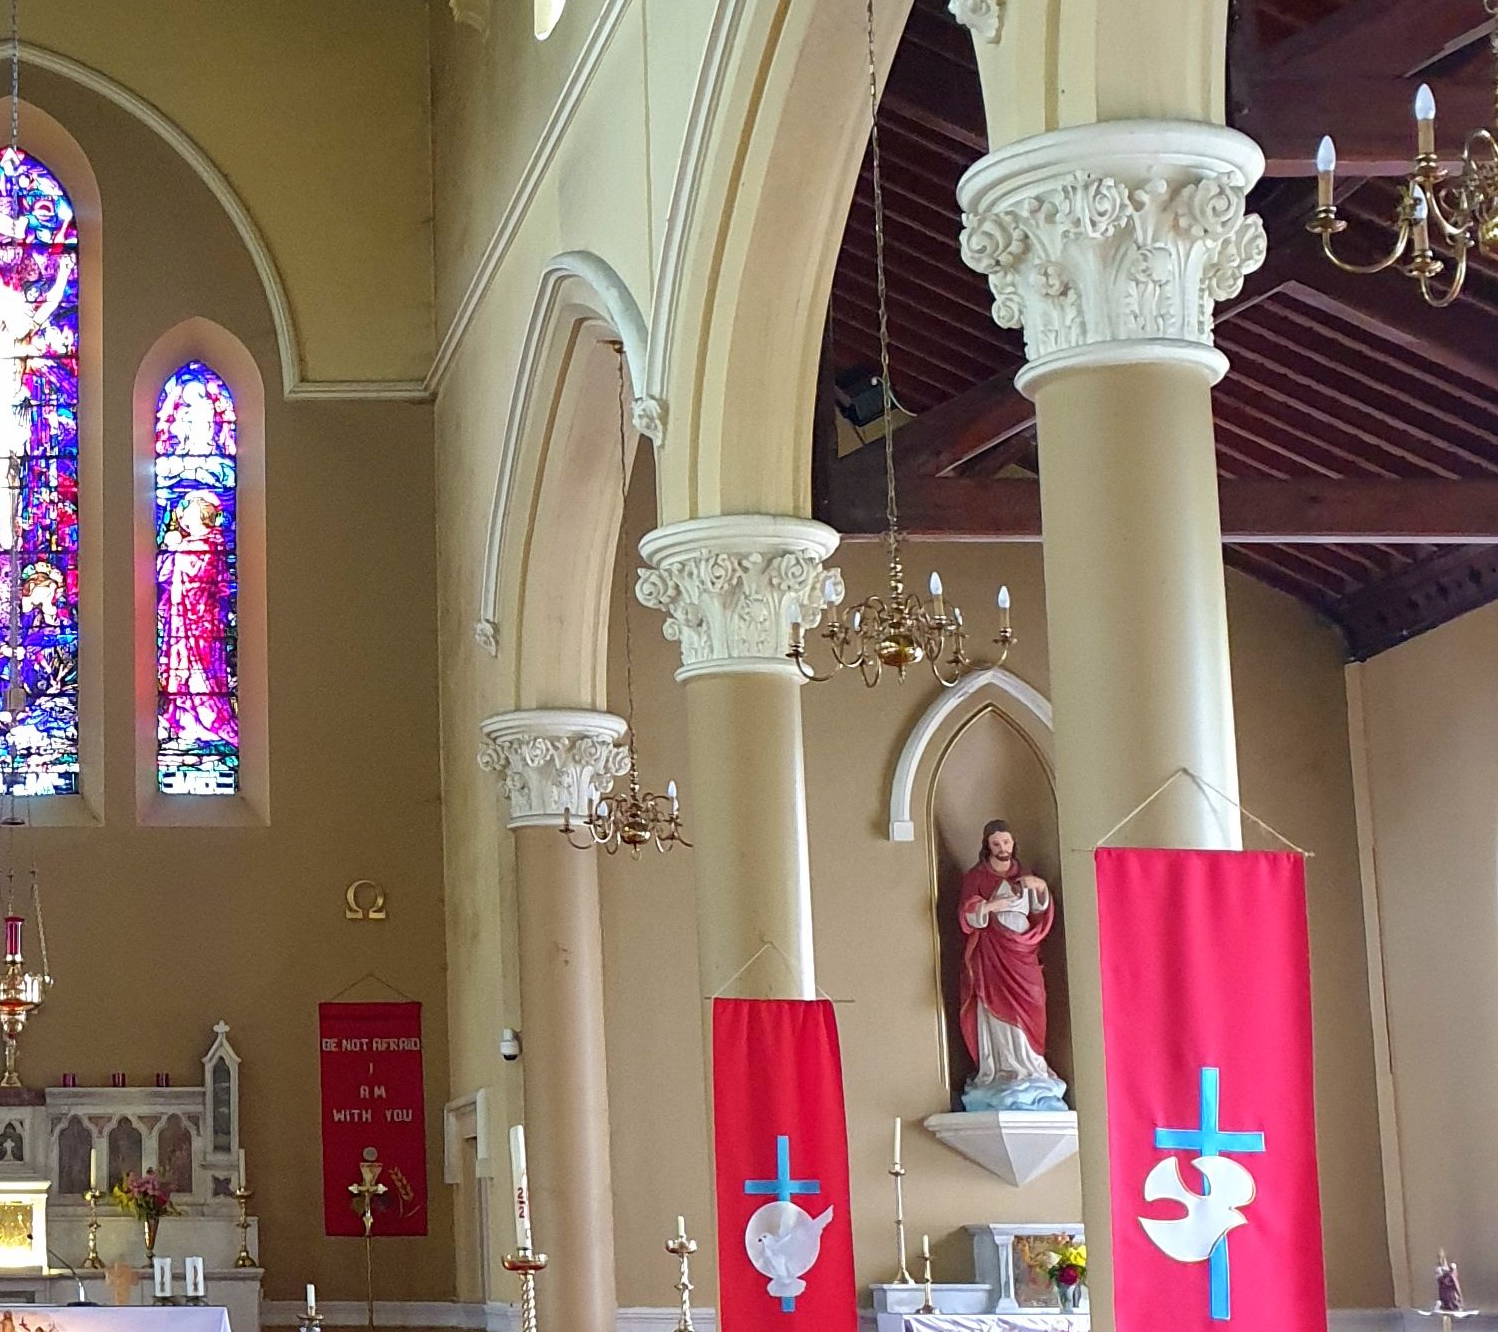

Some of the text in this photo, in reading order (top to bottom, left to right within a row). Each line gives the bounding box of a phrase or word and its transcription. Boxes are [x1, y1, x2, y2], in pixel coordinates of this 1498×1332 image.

[345, 879, 386, 920] Ω
[322, 1038, 420, 1051] BE NOT AFRAID
[333, 1109, 413, 1122] WITH YOU
